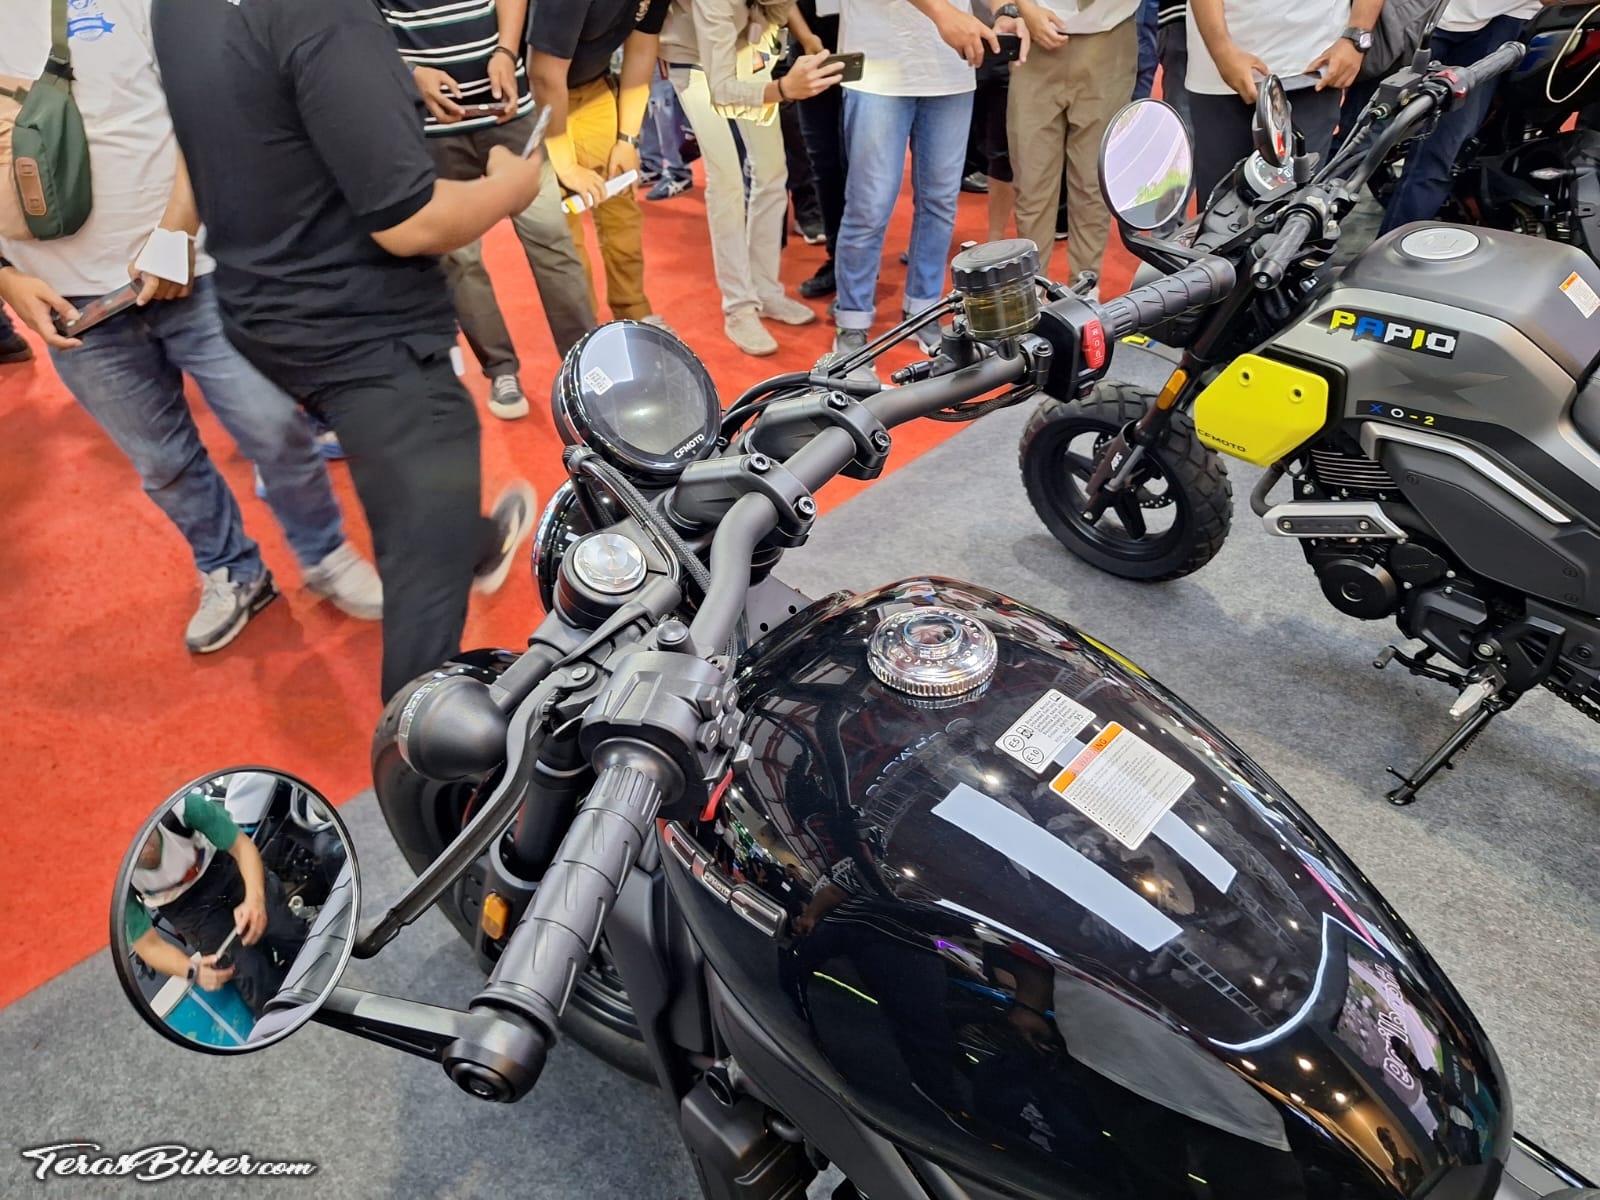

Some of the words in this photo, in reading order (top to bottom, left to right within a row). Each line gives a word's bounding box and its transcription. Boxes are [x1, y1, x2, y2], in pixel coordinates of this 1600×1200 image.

[1328, 309, 1457, 354] PAPIO
[673, 433, 706, 459] CFMOTO
[1008, 737, 1021, 749] E5
[1026, 749, 1040, 762] E10
[1080, 738, 1108, 767] WARNING
